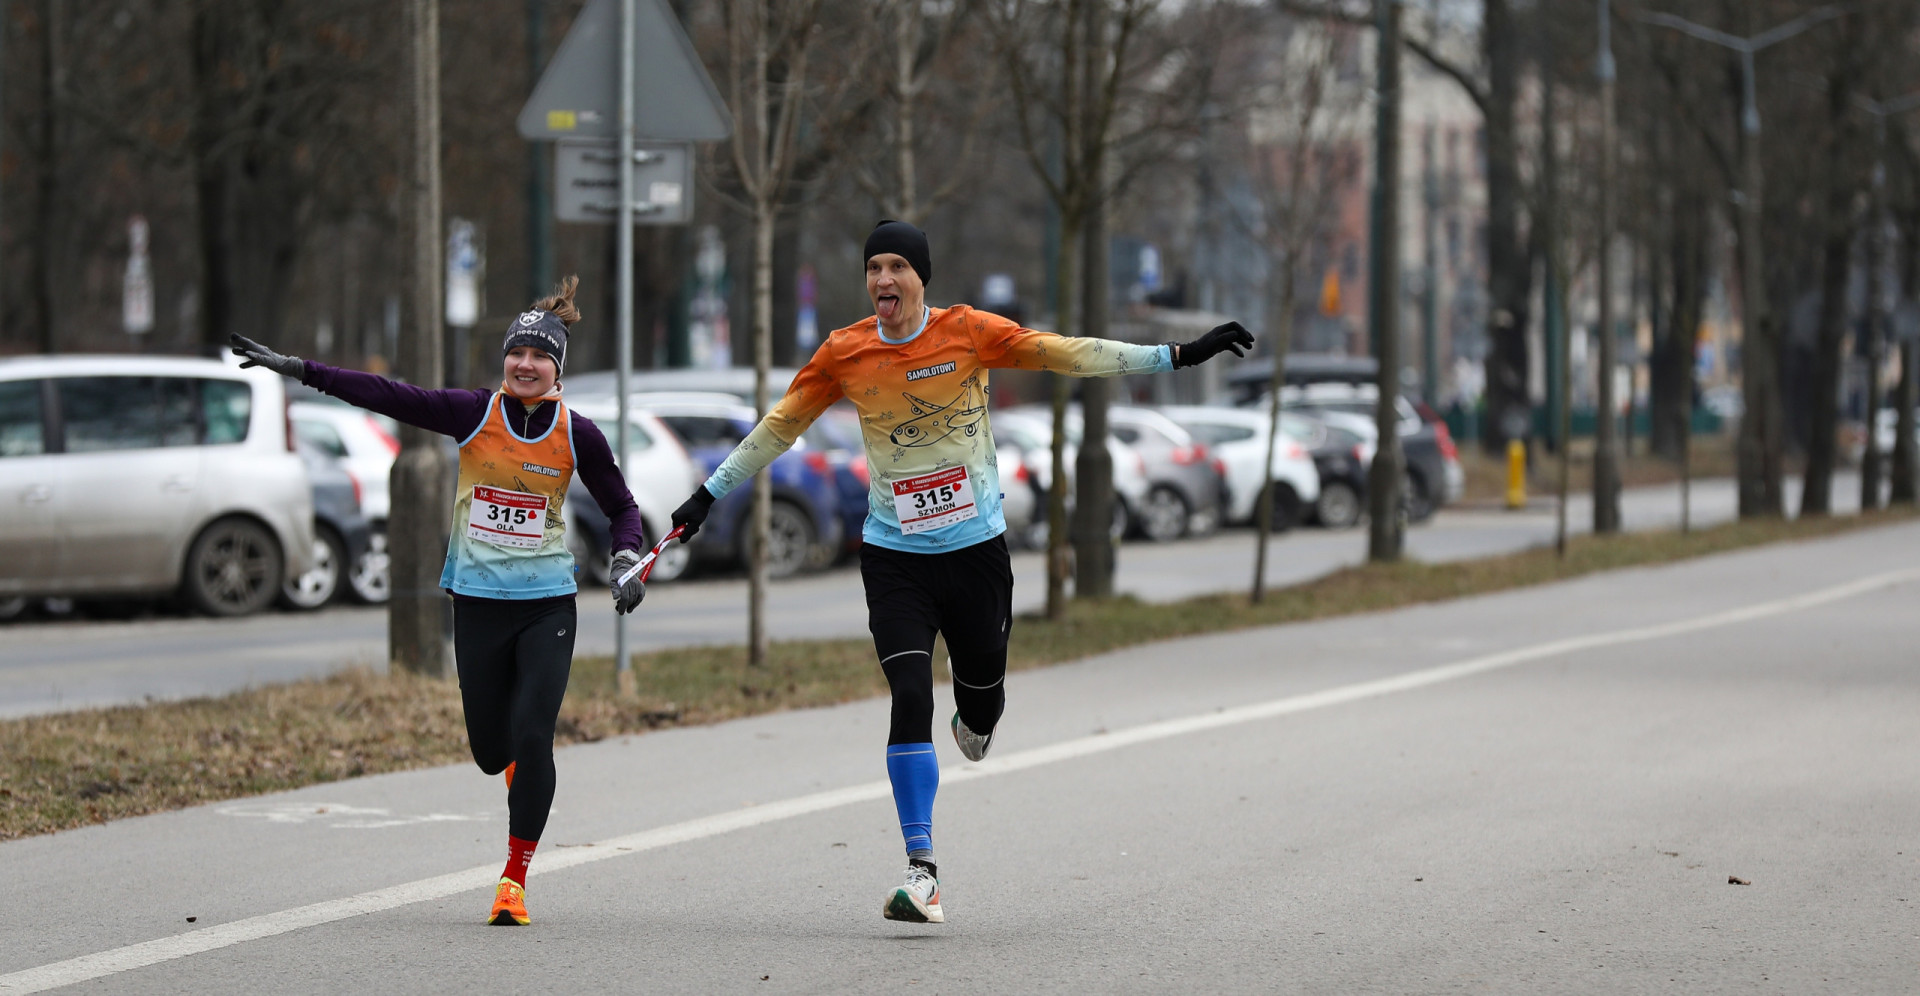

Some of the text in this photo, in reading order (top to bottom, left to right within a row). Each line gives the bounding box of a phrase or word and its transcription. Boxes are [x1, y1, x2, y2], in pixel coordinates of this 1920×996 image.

[539, 330, 546, 339] is
[907, 361, 956, 381] SAMOLOTOWY
[523, 462, 561, 477] SAMOLOTOWY
[912, 485, 954, 509] 315
[487, 504, 527, 525] 315
[917, 501, 957, 517] SZYMON
[496, 523, 515, 532] OLA
